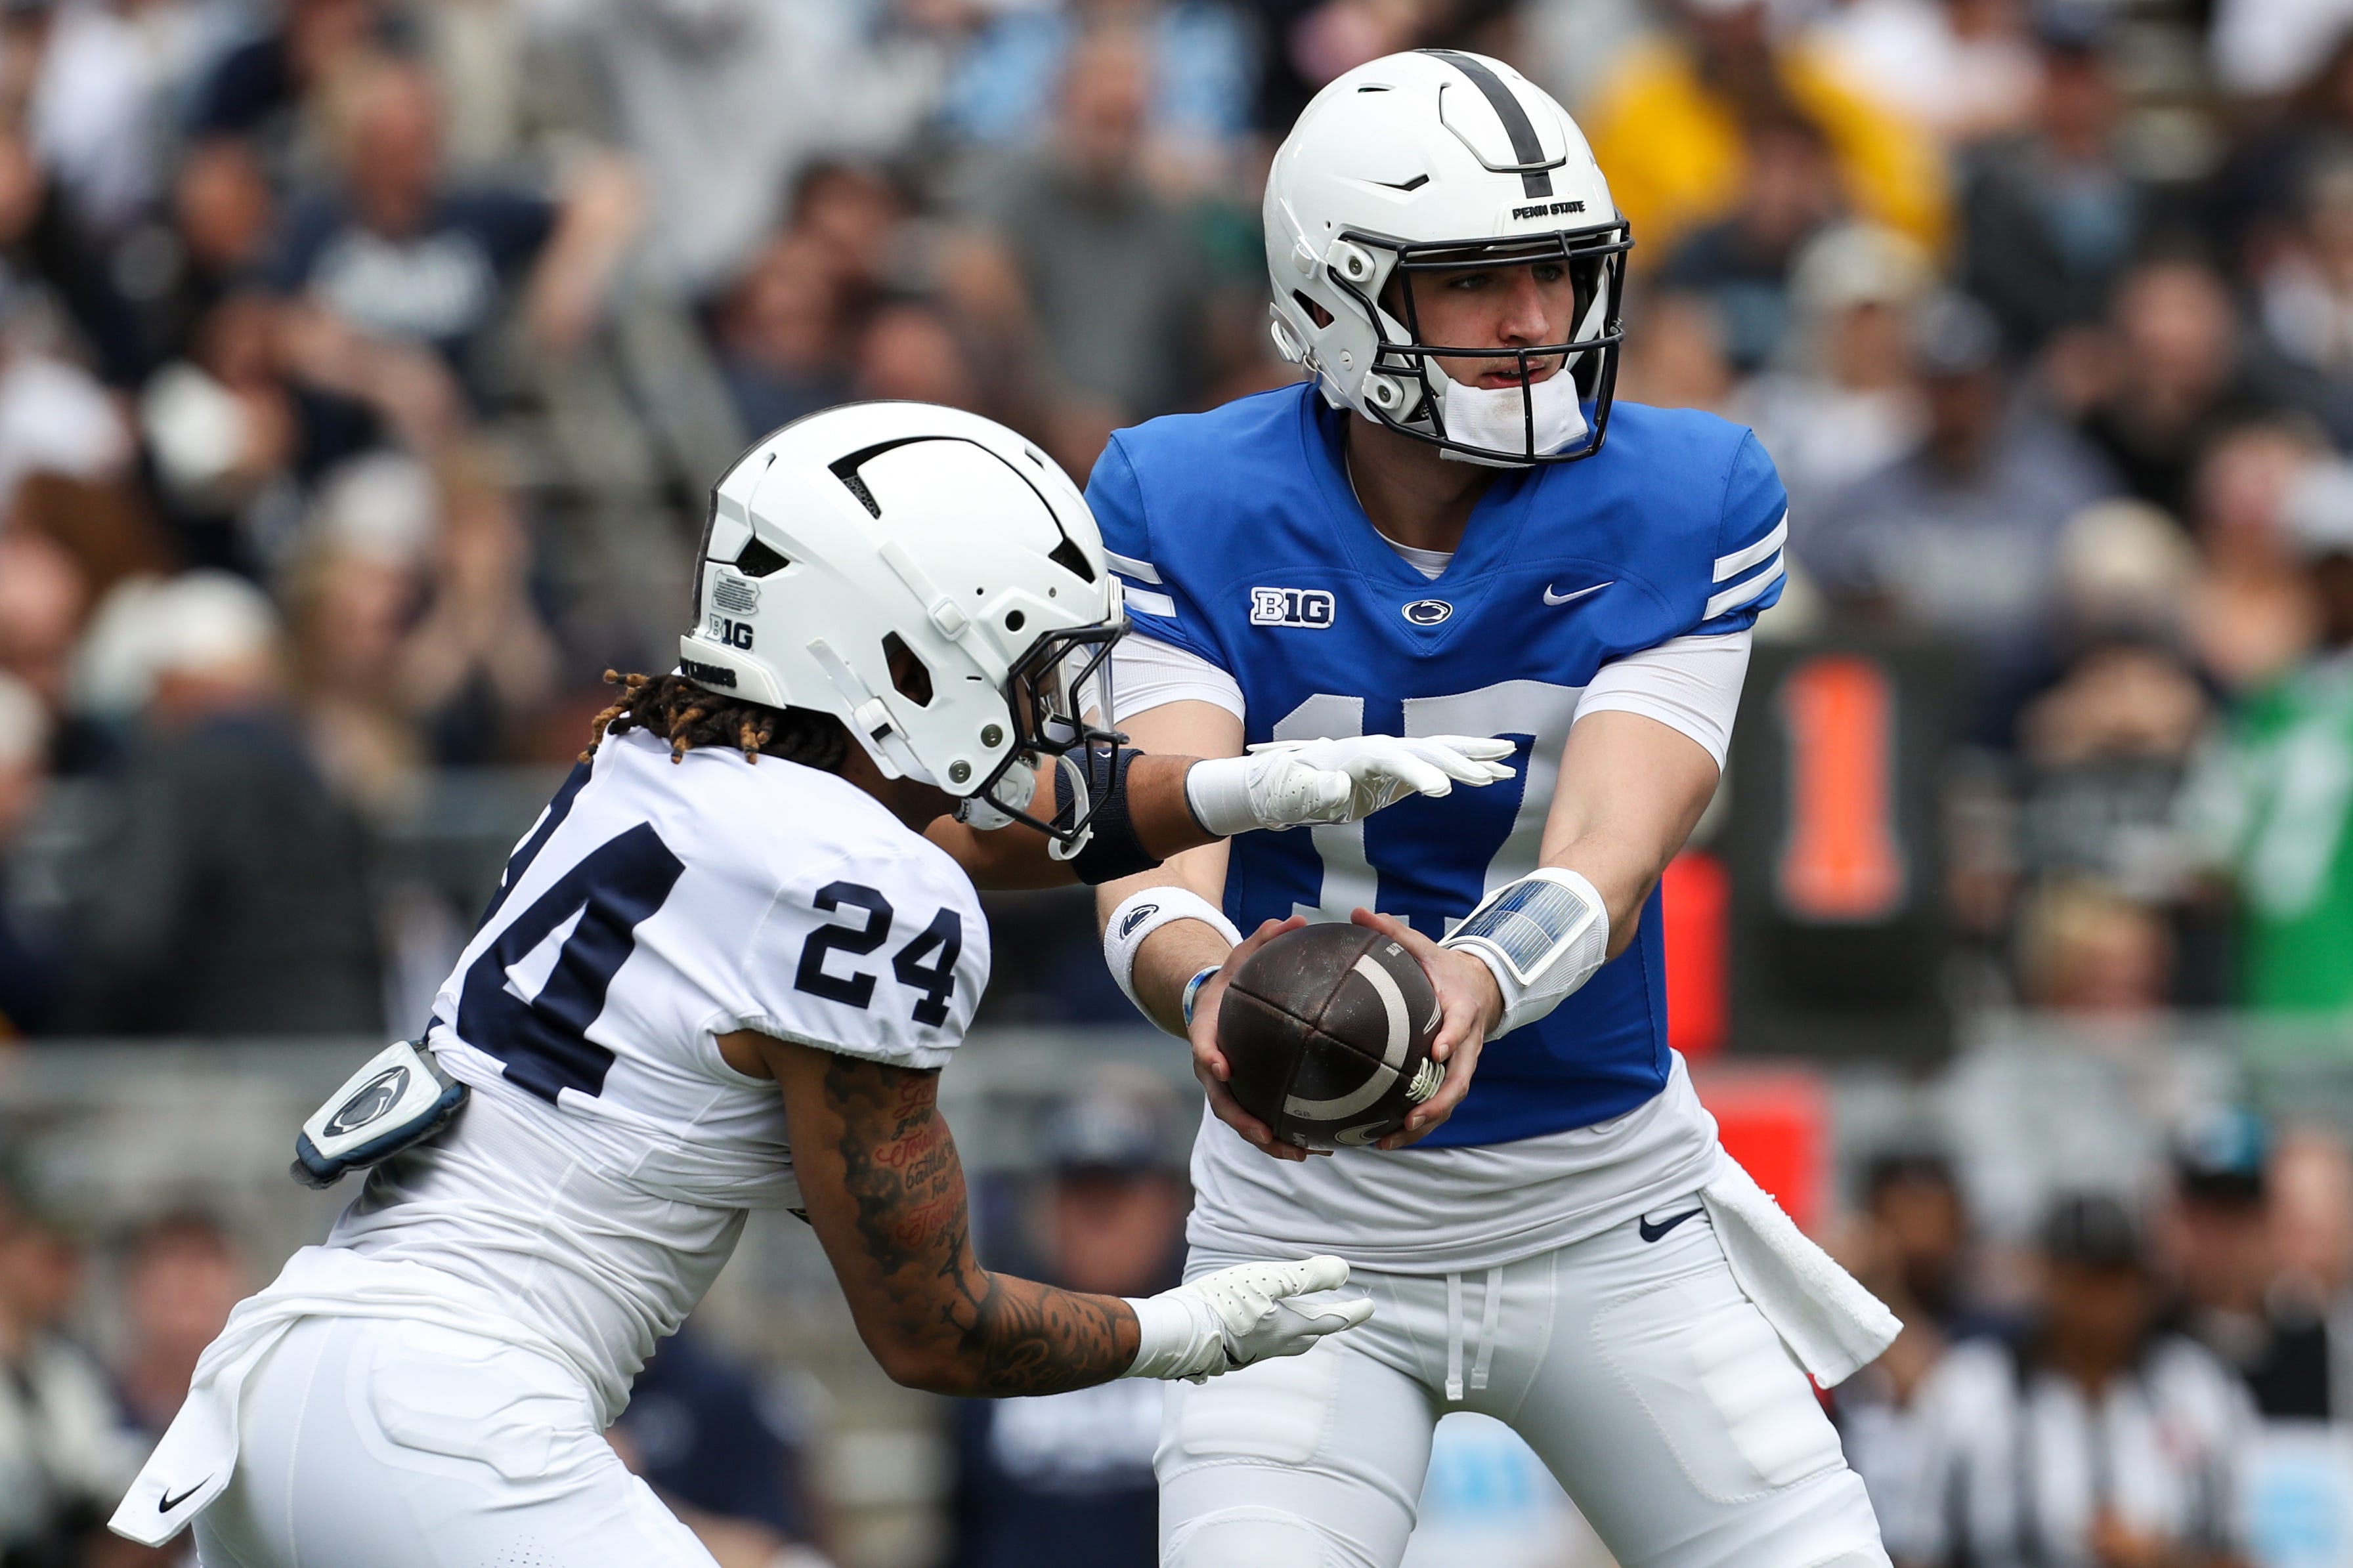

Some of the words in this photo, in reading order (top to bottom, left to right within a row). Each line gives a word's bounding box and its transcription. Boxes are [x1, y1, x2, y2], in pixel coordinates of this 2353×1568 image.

[1512, 205, 1549, 220] PENN
[1550, 201, 1586, 215] STATE
[1272, 679, 1585, 945] 17
[794, 881, 962, 1028] 24
